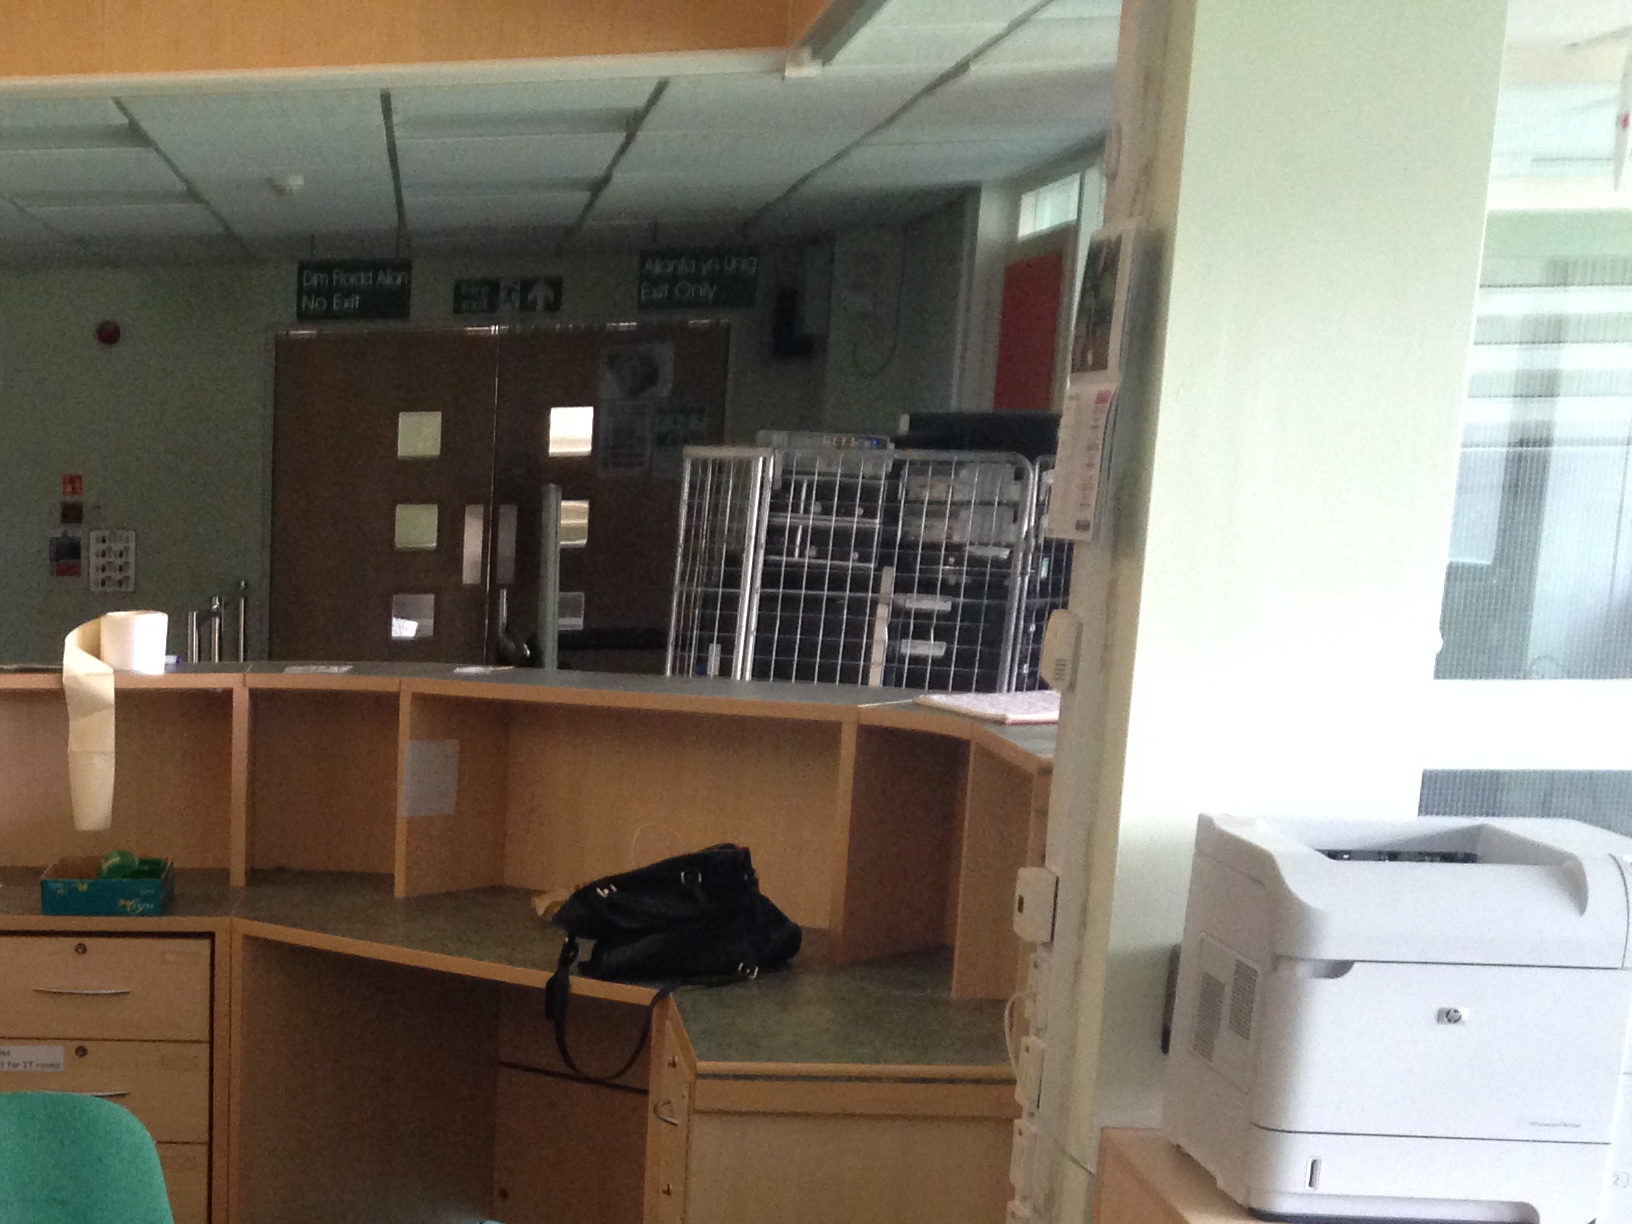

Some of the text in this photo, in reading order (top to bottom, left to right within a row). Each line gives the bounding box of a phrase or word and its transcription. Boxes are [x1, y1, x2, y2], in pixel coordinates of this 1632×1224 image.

[303, 270, 329, 286] Dim
[641, 281, 717, 300] Exit Only
[302, 293, 360, 311] No Exit
